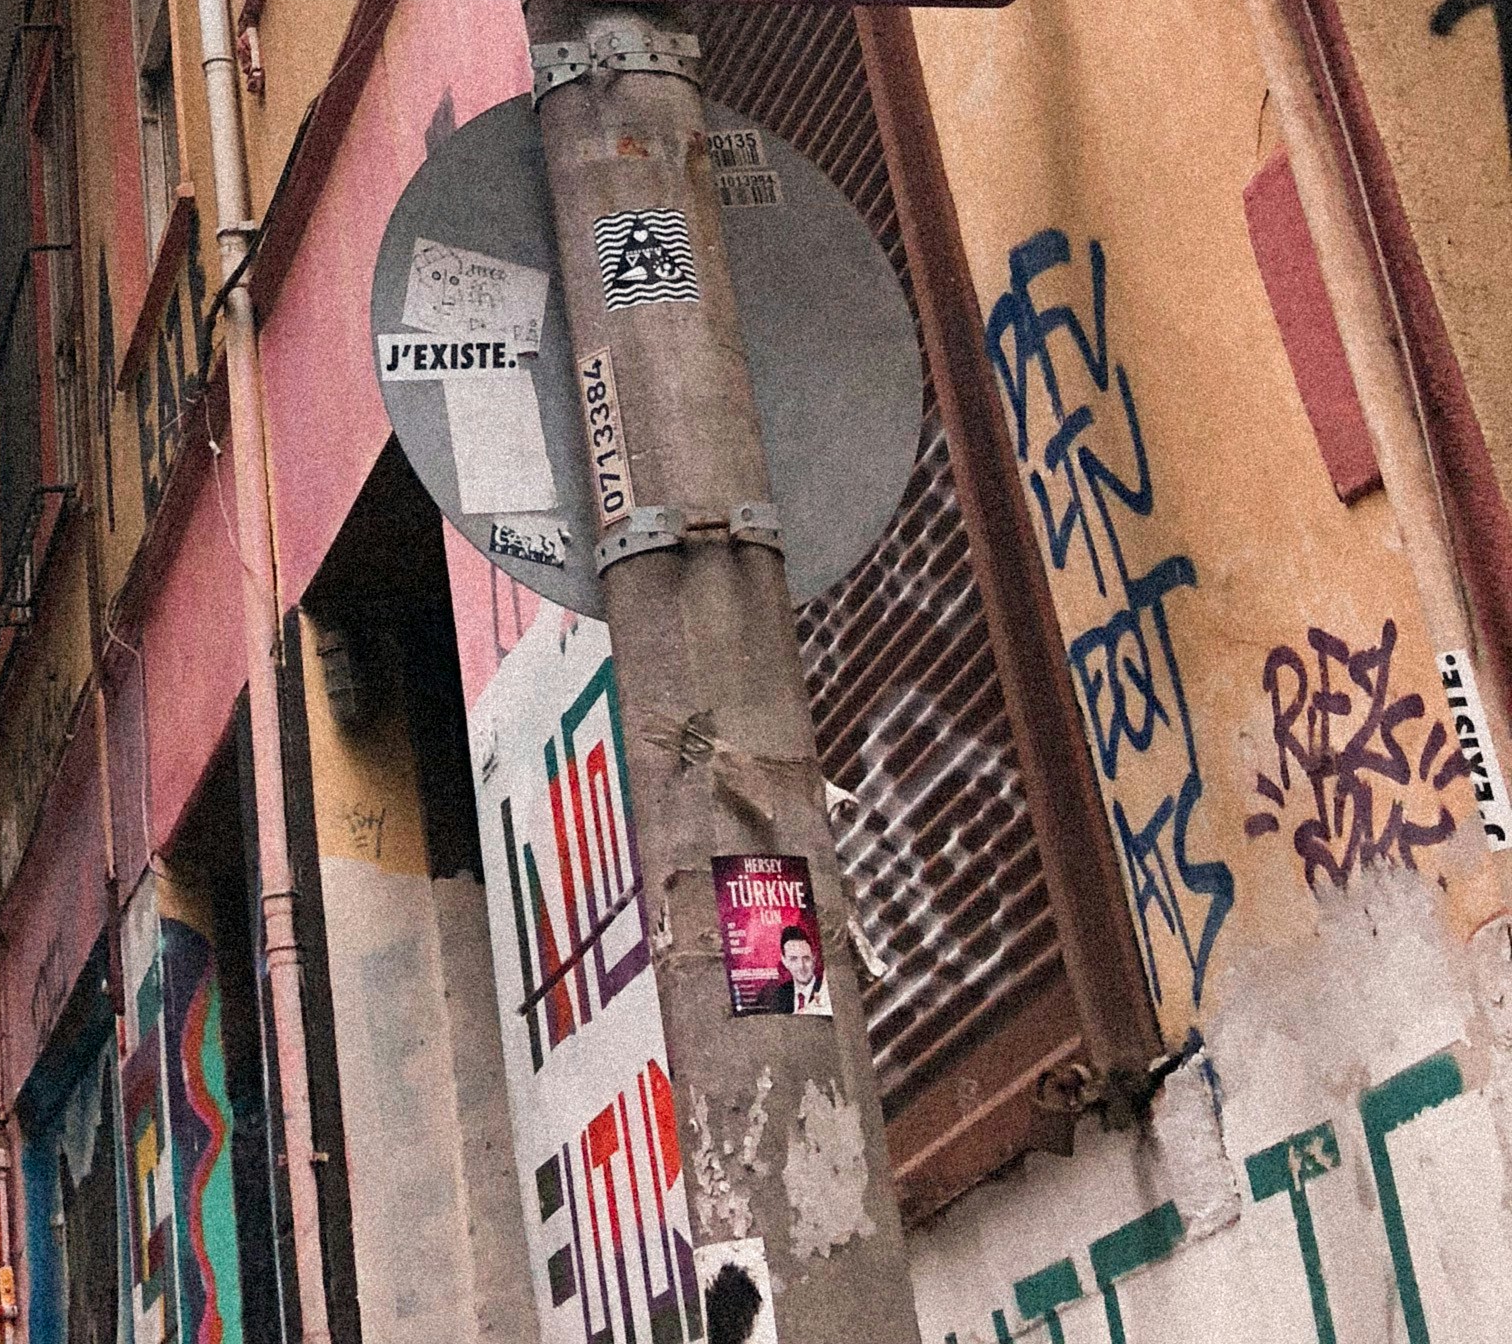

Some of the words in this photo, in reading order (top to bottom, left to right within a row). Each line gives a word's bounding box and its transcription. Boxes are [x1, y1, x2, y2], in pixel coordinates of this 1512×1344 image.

[386, 342, 517, 372] J'EXISTE.
[583, 358, 624, 514] 0713384
[726, 874, 807, 909] TÜRKİYE
